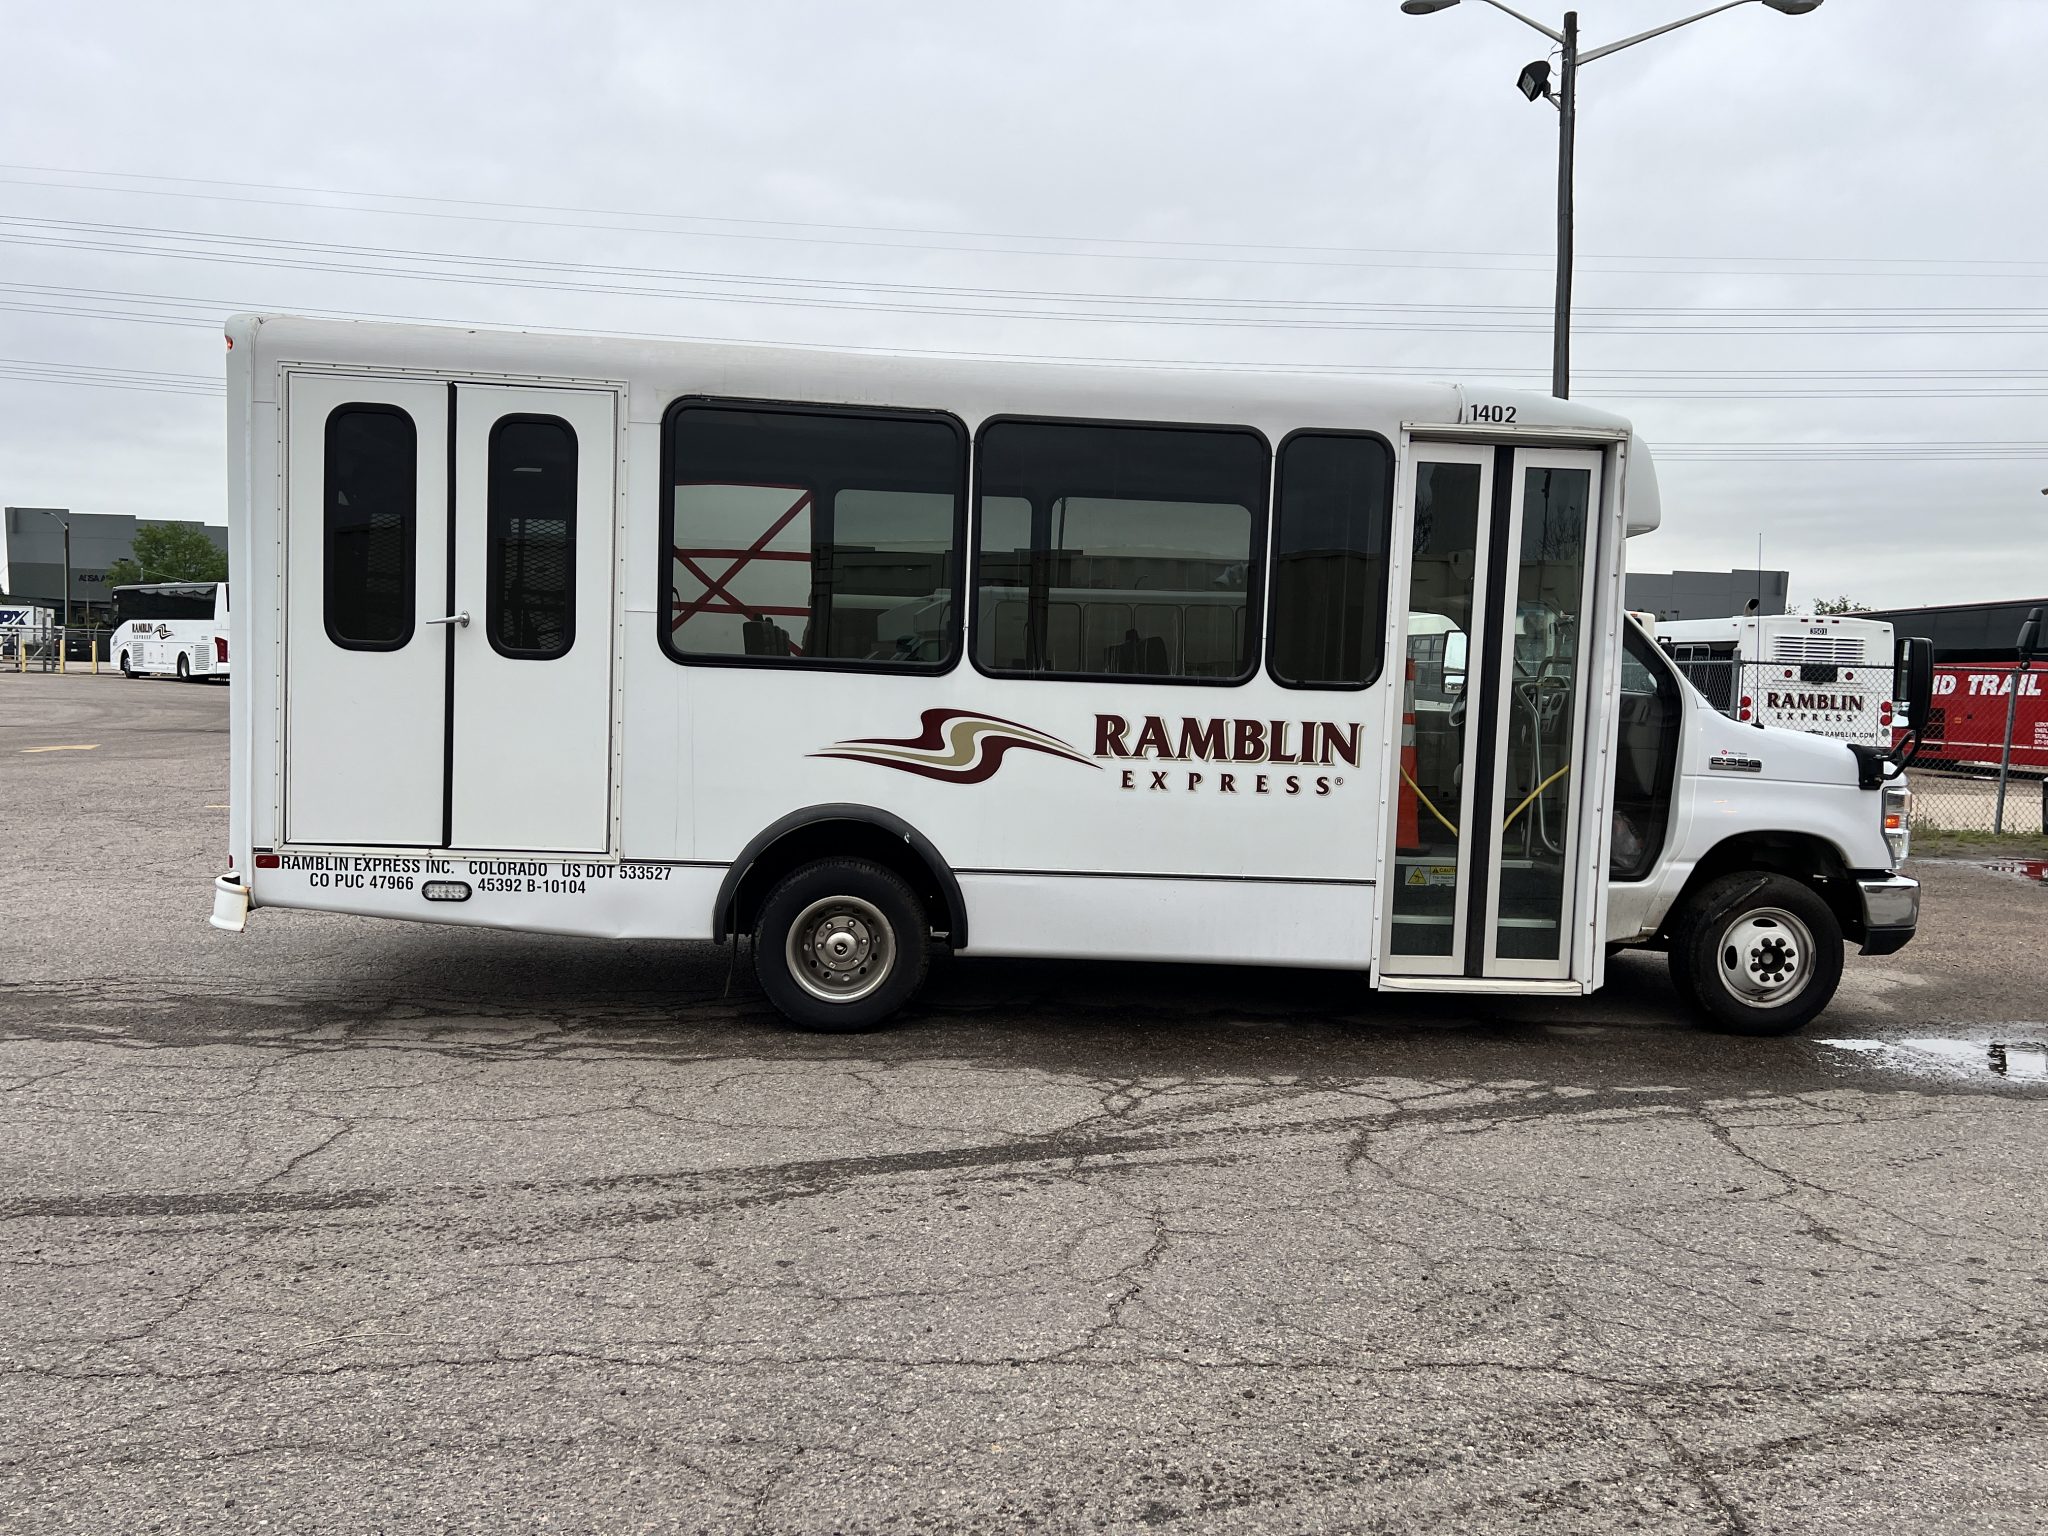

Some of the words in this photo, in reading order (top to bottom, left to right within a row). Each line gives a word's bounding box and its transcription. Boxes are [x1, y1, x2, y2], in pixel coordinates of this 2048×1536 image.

[1470, 404, 1517, 423] 1402
[132, 623, 153, 633] RAMBLIN
[1967, 674, 2042, 696] TRAIL
[1766, 692, 1864, 712] RAMBLIN
[1776, 713, 1853, 722] EXPRESS
[1093, 713, 1365, 768] RAMBLIN
[281, 855, 349, 871] RAMBLIN
[354, 857, 421, 873] EXPRESS
[425, 859, 455, 875] INC.
[468, 861, 548, 877] COLORADO
[561, 863, 581, 878] US
[586, 865, 616, 879] DOT
[619, 865, 672, 881] 533527
[309, 872, 330, 887] CO
[334, 873, 365, 889] PUC
[369, 875, 414, 891] 47966
[477, 878, 522, 892] 45392
[527, 879, 586, 894] B-10104
